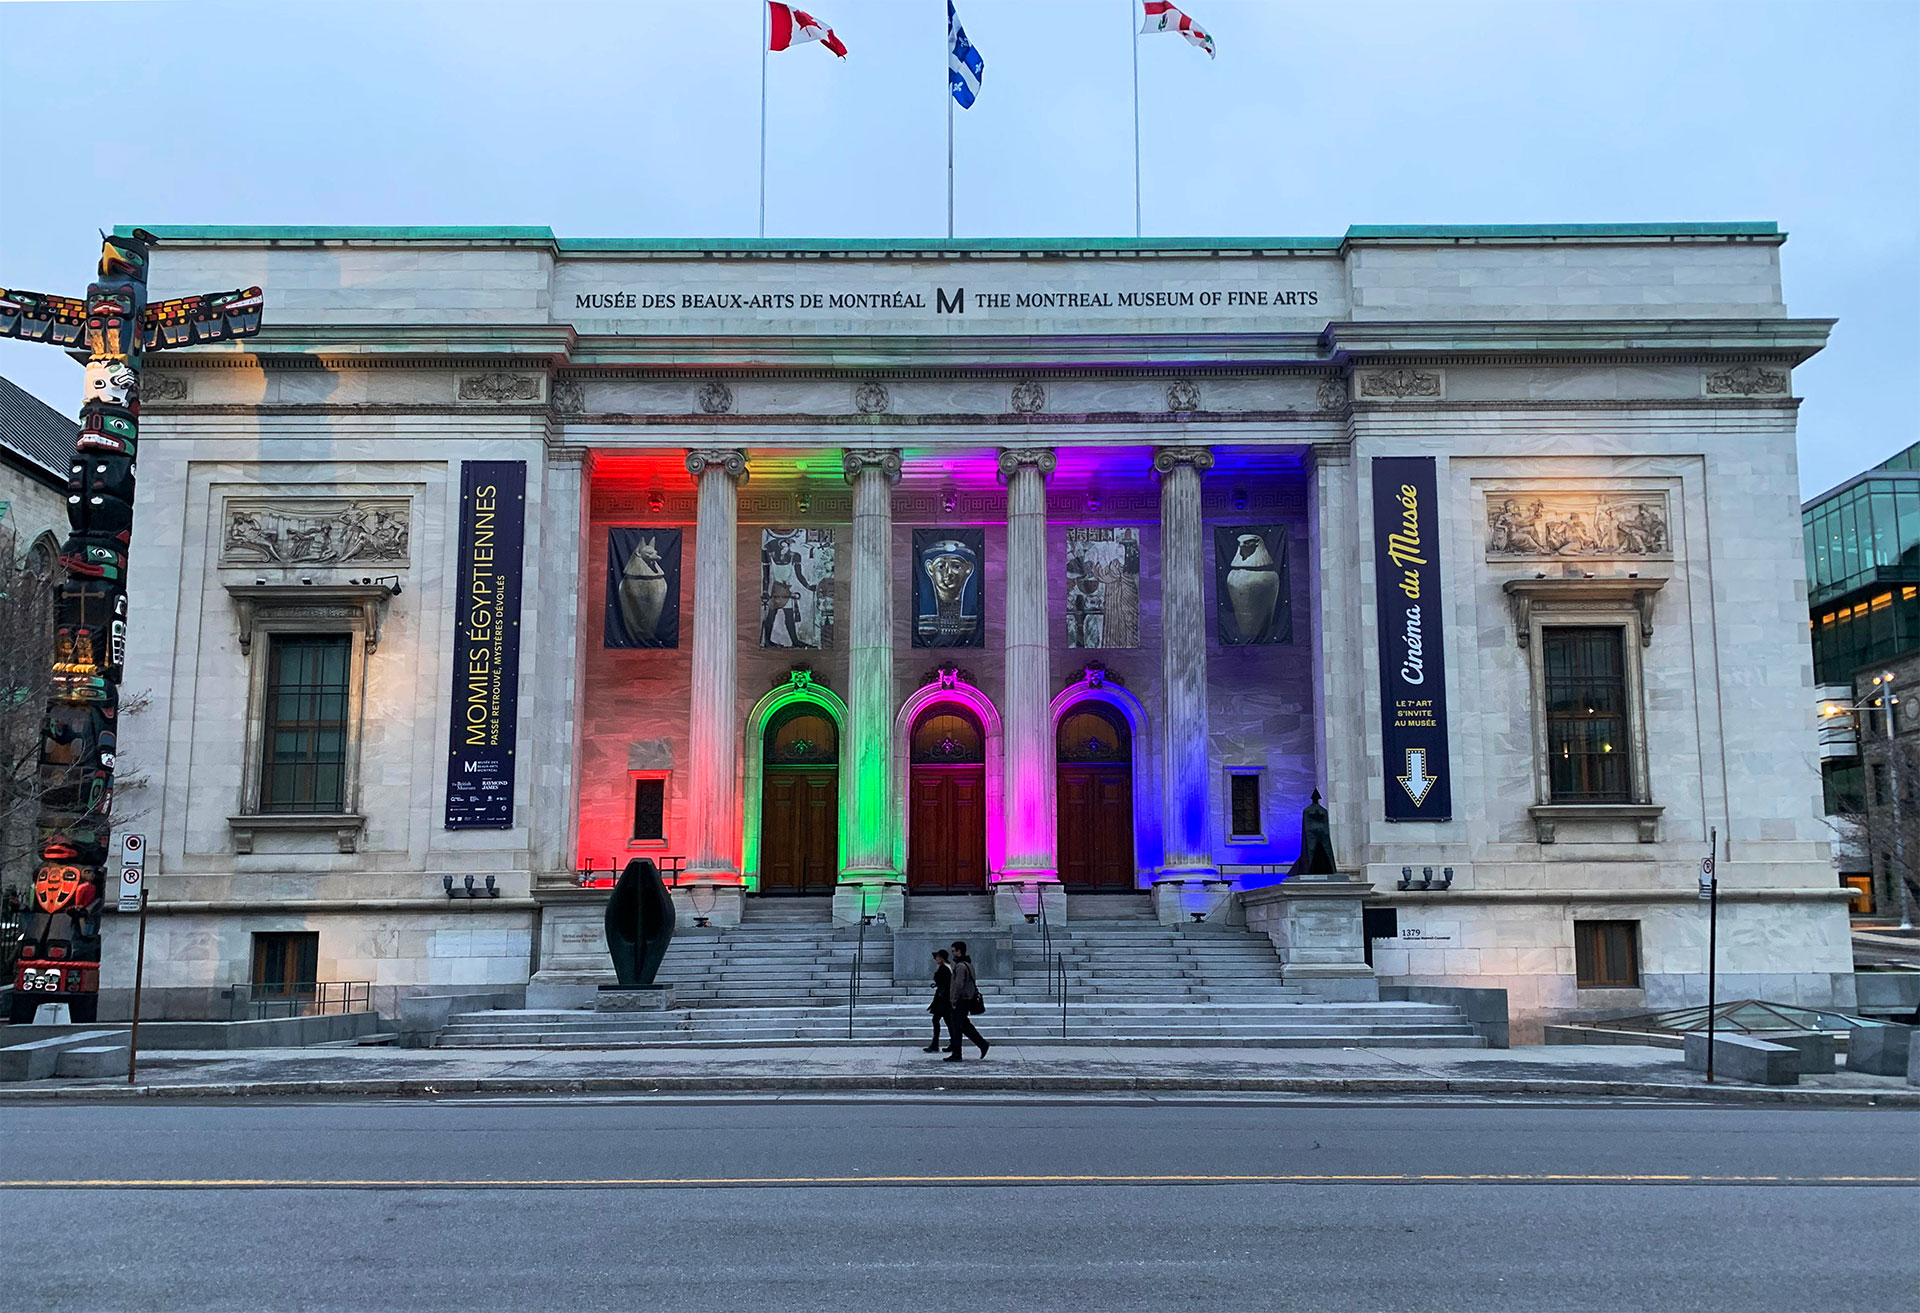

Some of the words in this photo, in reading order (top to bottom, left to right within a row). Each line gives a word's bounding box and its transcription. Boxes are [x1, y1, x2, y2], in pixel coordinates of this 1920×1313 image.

[575, 291, 637, 309] MUSÉE
[641, 294, 676, 309] DES
[681, 293, 795, 309] BEAUX-ARTS
[799, 294, 824, 309] DE
[828, 291, 926, 309] MONTRÉAL
[936, 287, 964, 314] M
[974, 293, 1011, 308] THE
[1015, 292, 1114, 308] MONTREAL
[1117, 291, 1194, 307] MUSEUM
[1199, 291, 1222, 306] OF
[1227, 291, 1268, 306] FINE
[1272, 290, 1318, 306] ARTS
[1387, 484, 1428, 568] Musée
[465, 485, 497, 641] ÉGYPTIENNES
[494, 575, 506, 616] DÉVOILÉS
[1399, 569, 1420, 599] du
[1400, 604, 1424, 685] Cinéma
[466, 647, 491, 746] MOMIES
[491, 667, 503, 717] RETROUVÉ,
[490, 718, 500, 746] PASSÉ
[1407, 719, 1437, 727] MUSÉE
[464, 760, 477, 773] M
[1402, 928, 1421, 937] 1379
